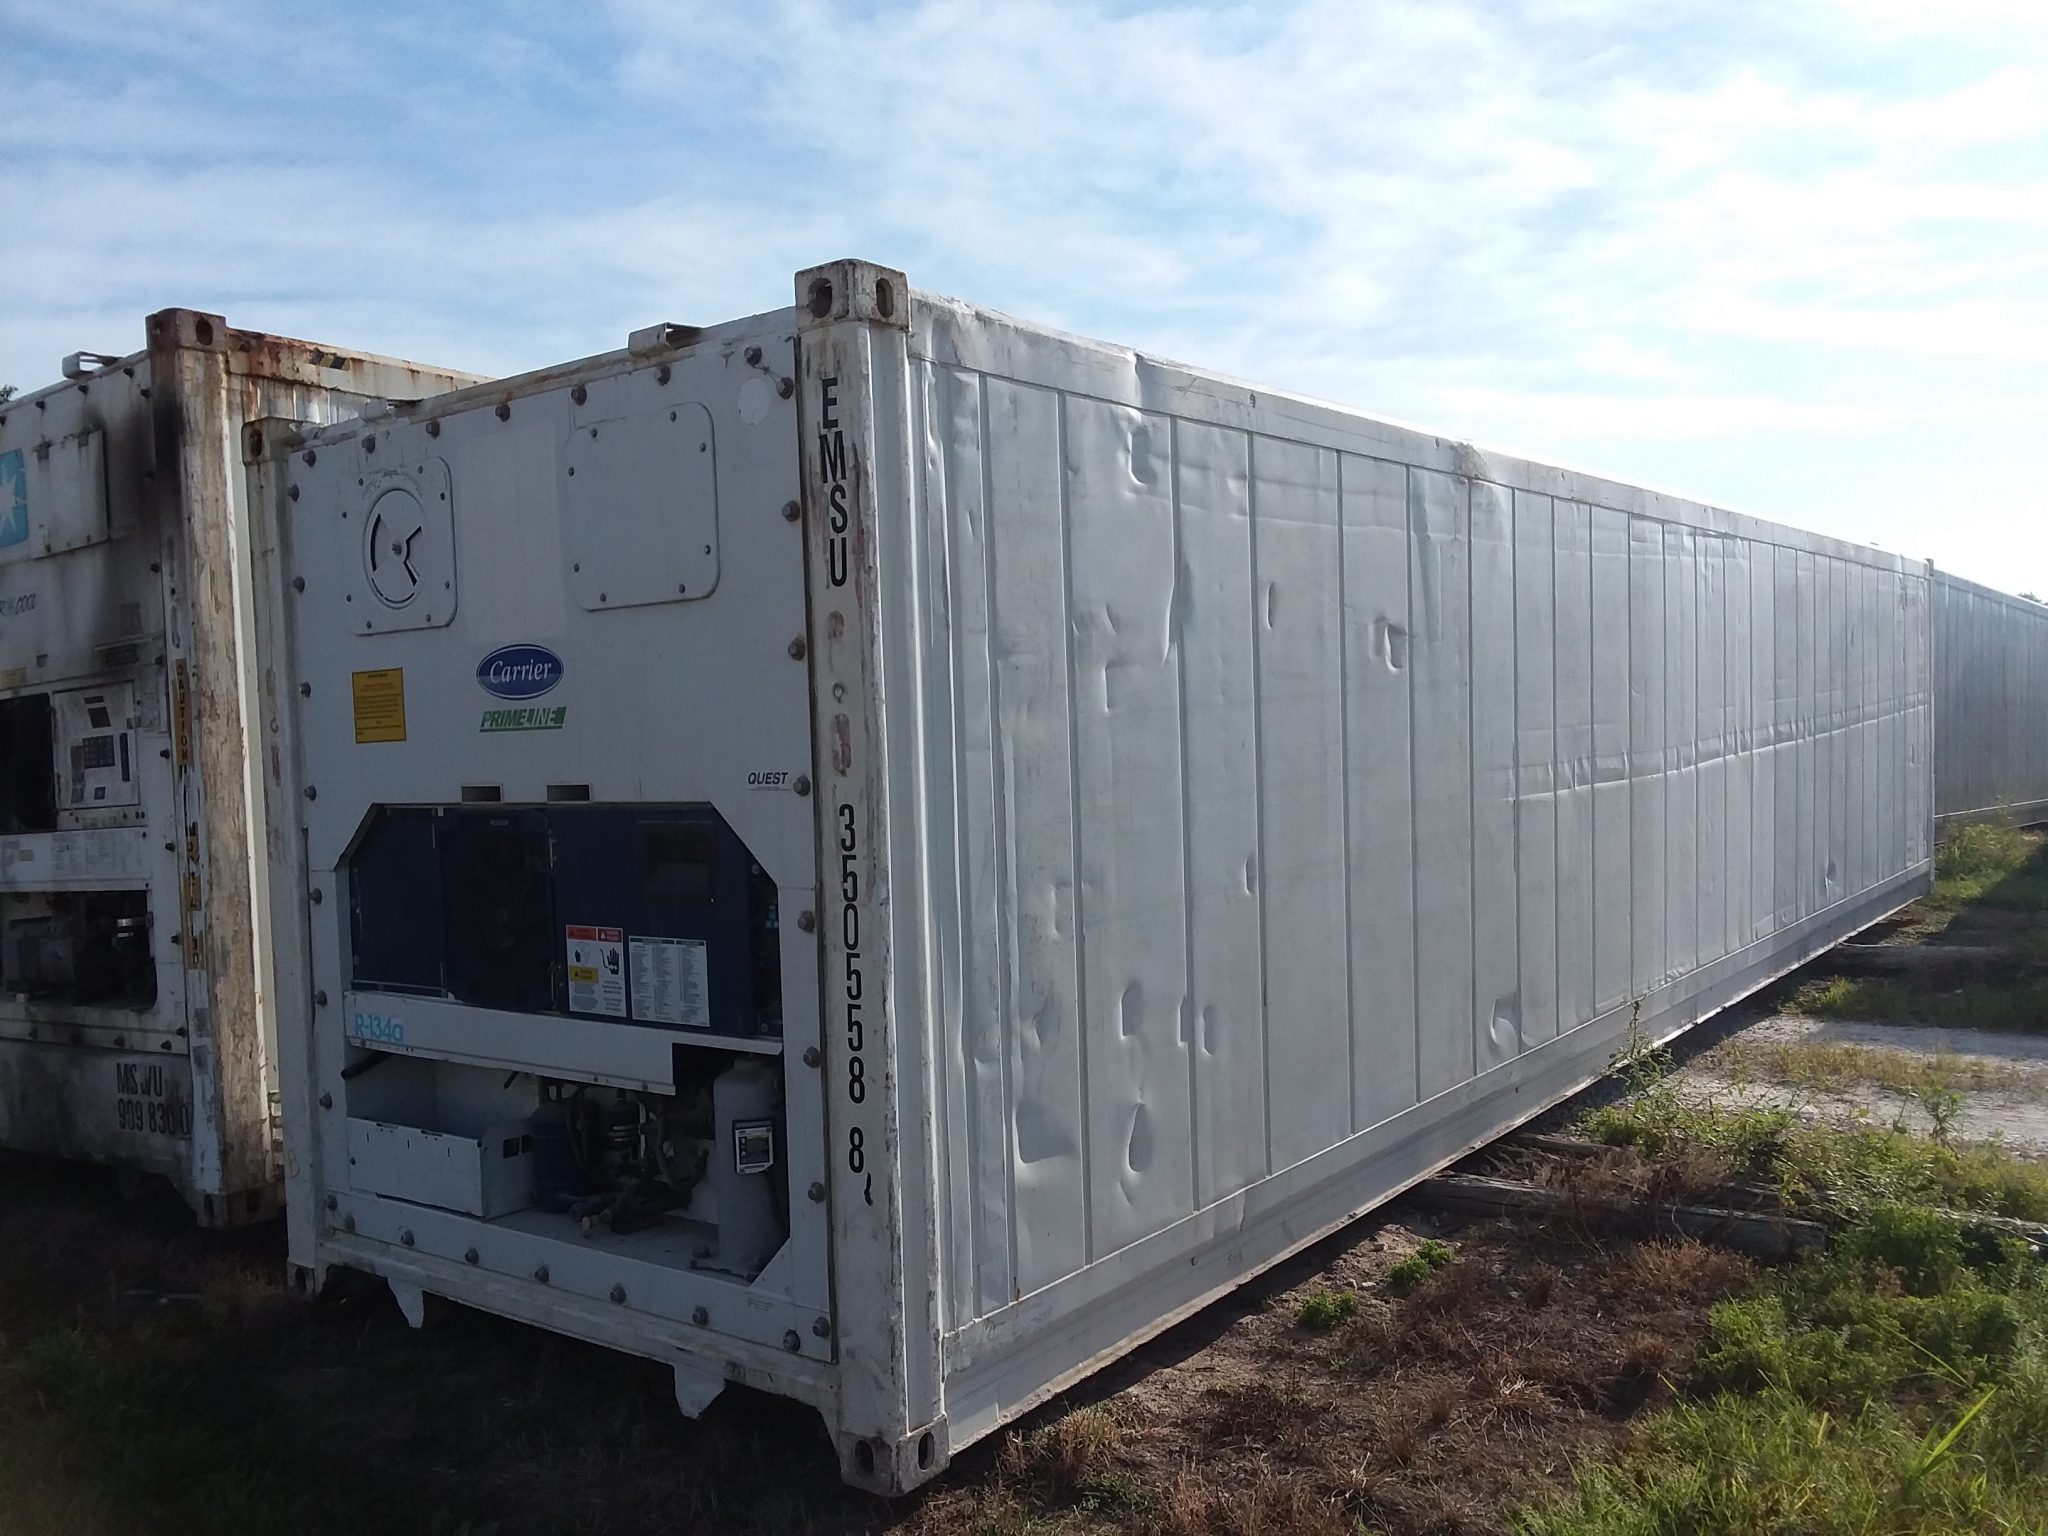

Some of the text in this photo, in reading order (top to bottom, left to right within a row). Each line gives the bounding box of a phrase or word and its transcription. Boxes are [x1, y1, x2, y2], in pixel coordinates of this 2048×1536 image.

[818, 377, 848, 587] EMSU
[489, 658, 553, 684] Carrier
[481, 708, 562, 729] PRIMELINE
[747, 772, 789, 785] QUEST
[839, 804, 866, 1174] 350558 8
[355, 1013, 403, 1042] R-134a
